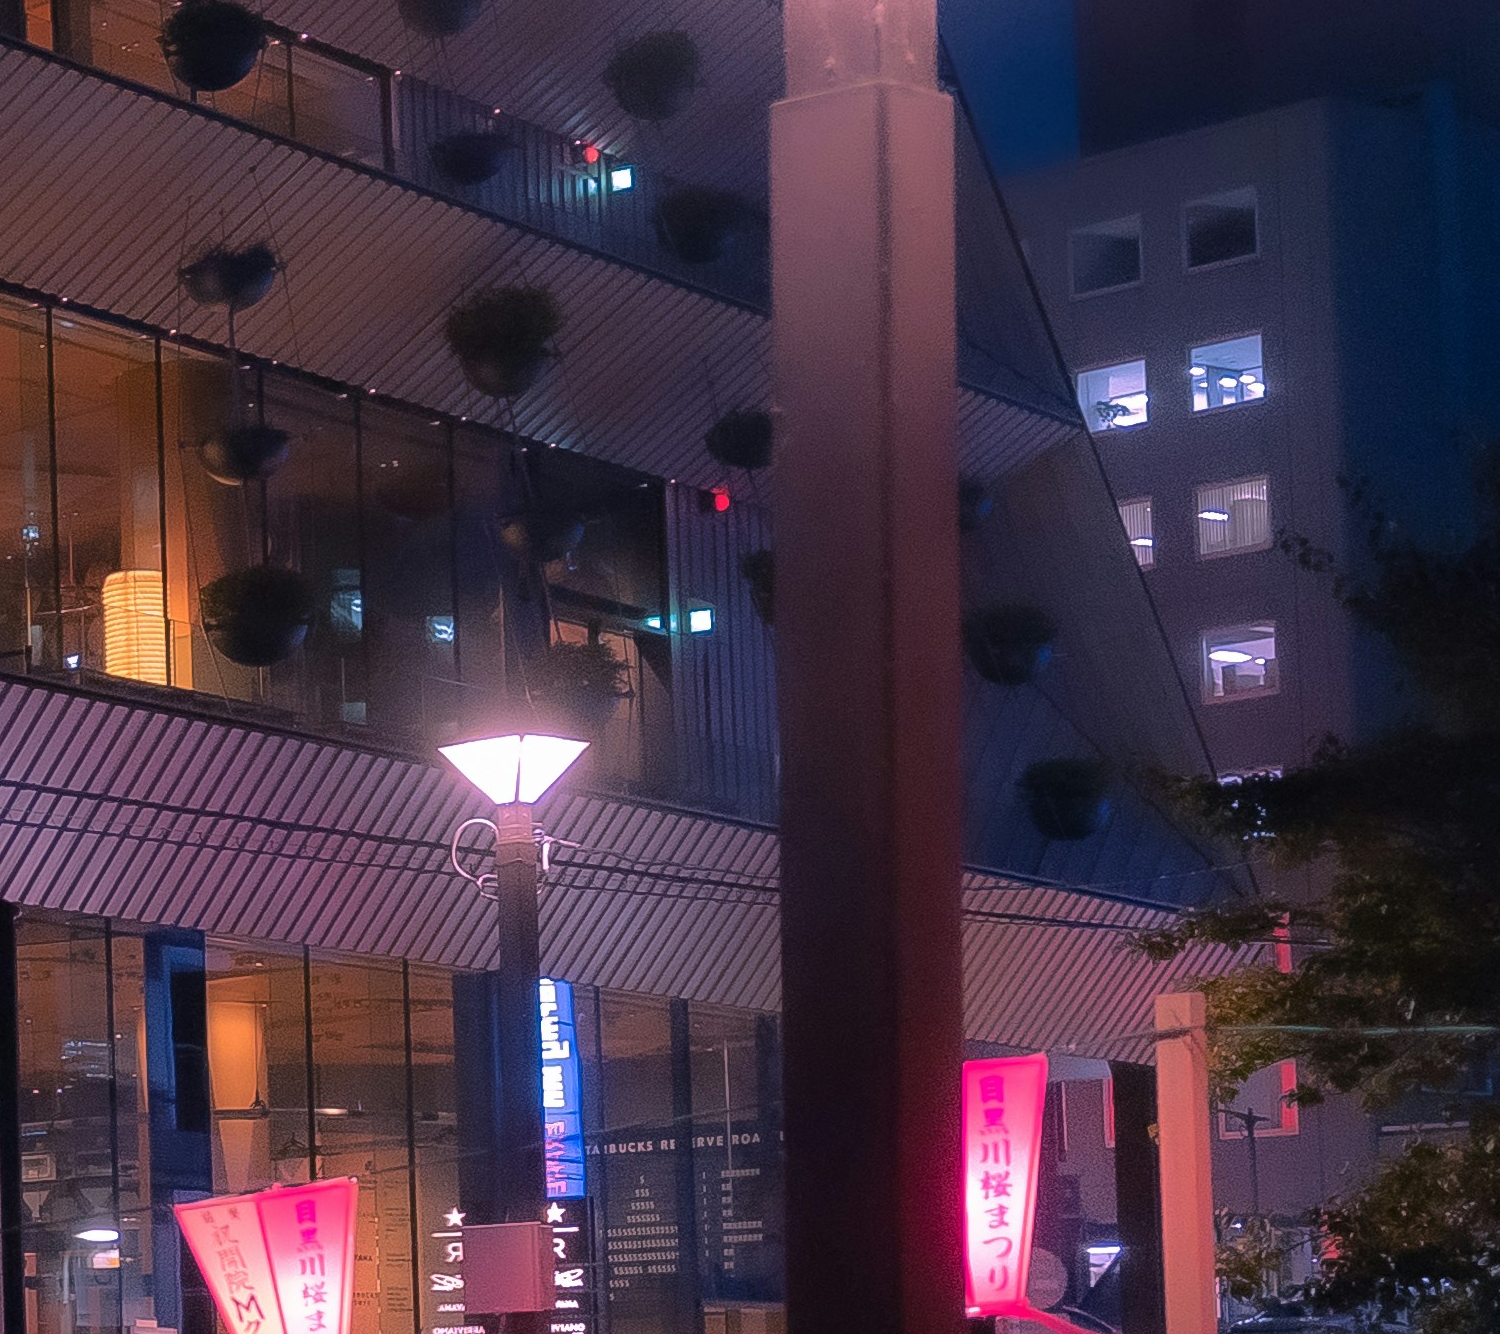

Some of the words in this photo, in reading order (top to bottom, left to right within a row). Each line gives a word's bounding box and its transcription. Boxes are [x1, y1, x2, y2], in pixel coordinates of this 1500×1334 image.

[979, 1075, 1013, 1292] 目黒川桜まつり
